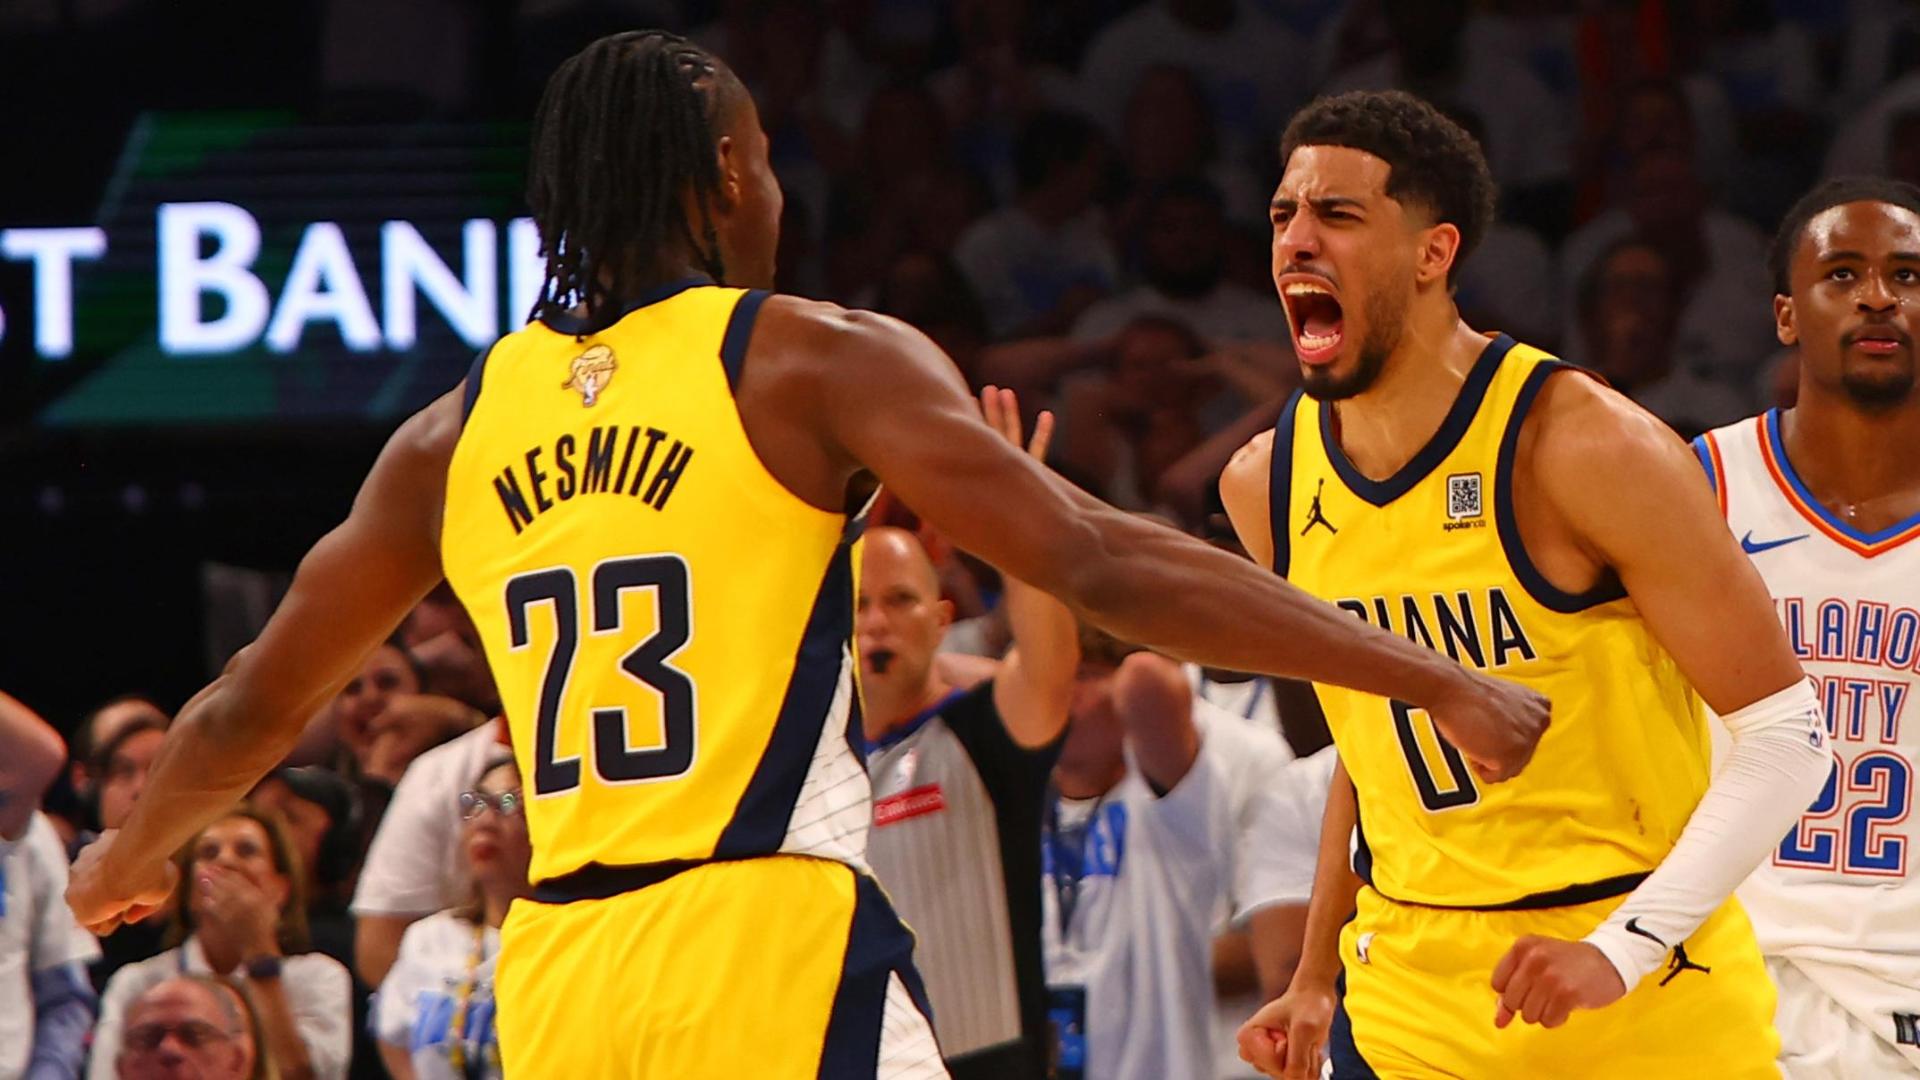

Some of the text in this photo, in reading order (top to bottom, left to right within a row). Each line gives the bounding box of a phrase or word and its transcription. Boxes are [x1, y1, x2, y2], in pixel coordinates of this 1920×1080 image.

[0, 226, 107, 358] T
[492, 425, 694, 536] NESMITH
[504, 552, 699, 798] 23
[1774, 597, 1920, 674] LAHO
[1805, 674, 1910, 744] ITY
[1772, 750, 1913, 877] 22
